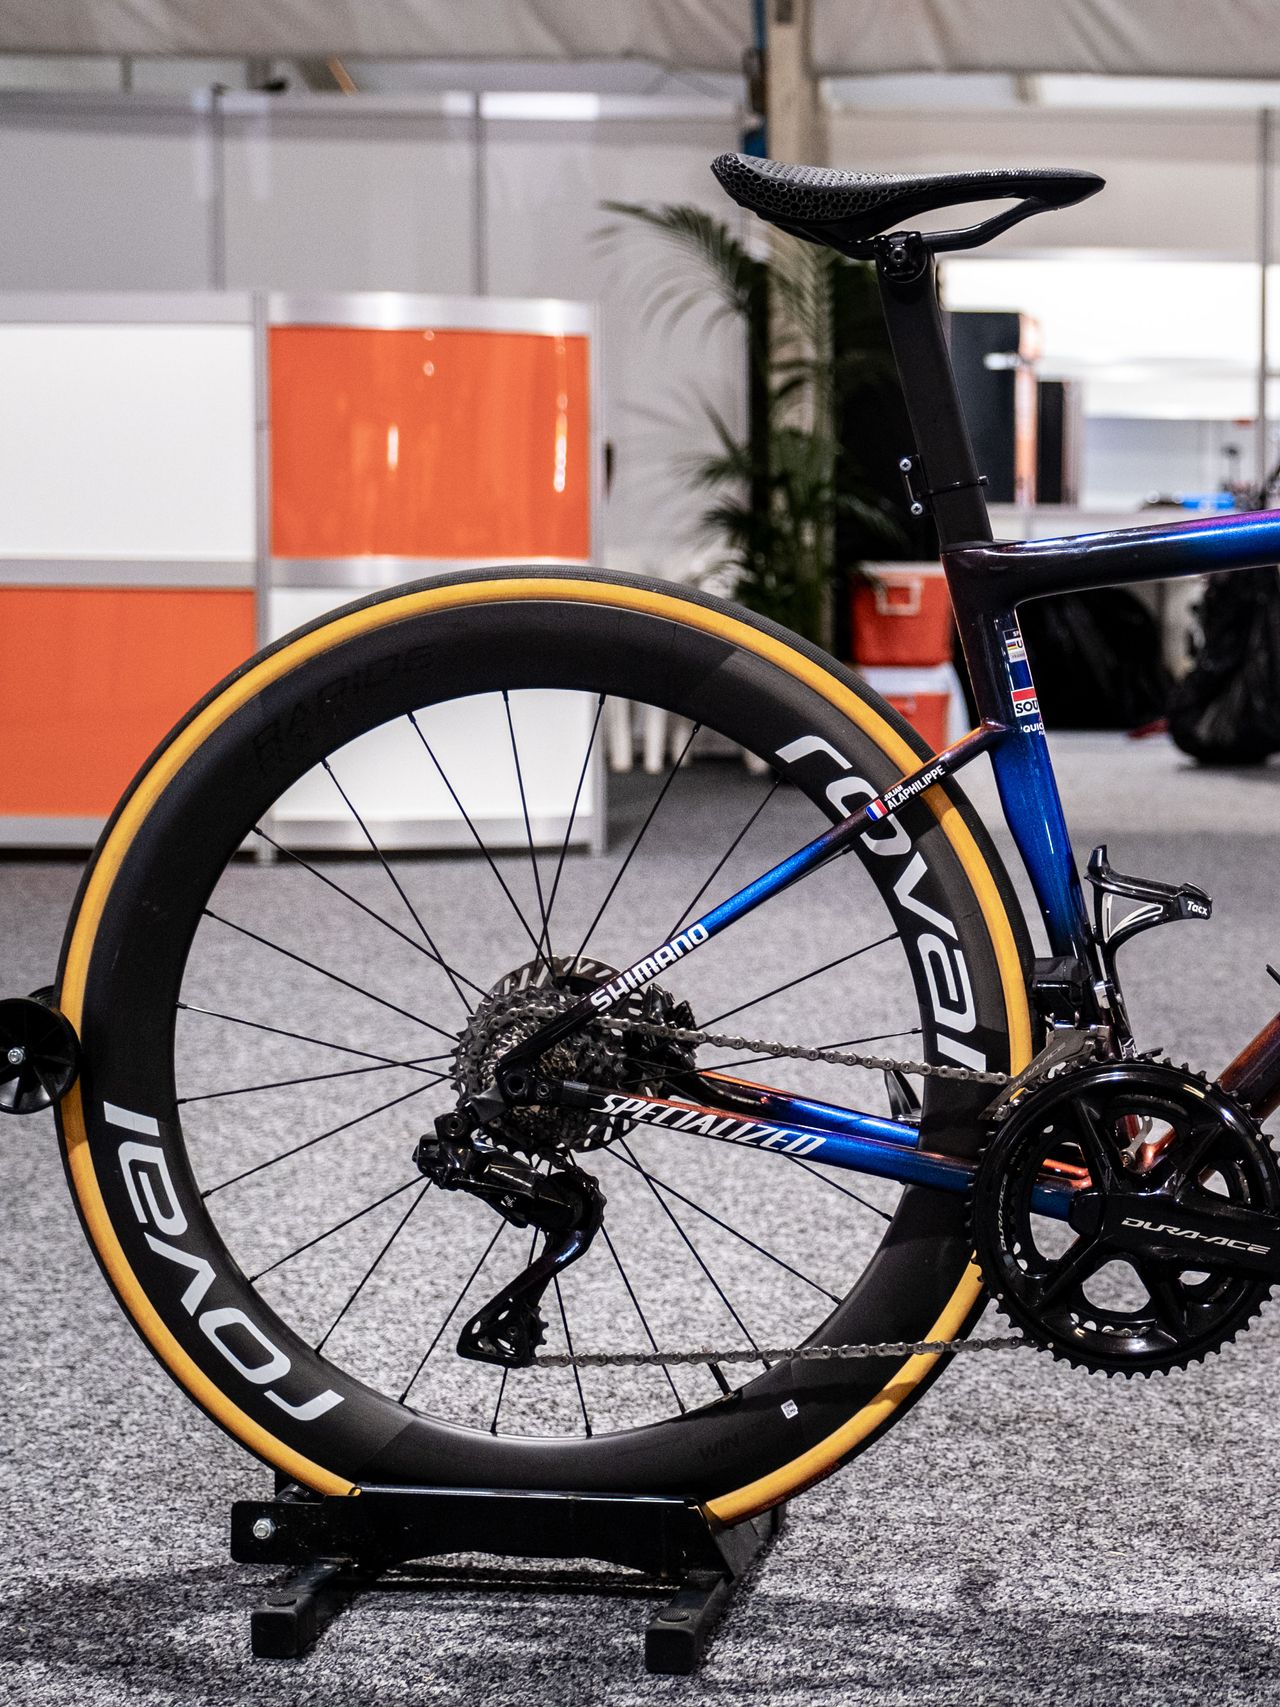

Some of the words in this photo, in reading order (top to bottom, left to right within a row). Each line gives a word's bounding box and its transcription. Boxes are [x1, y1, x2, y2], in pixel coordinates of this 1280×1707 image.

[883, 784, 904, 802] JULIAN
[886, 764, 946, 811] ALAPHILIPPE
[1187, 900, 1208, 916] Tacx
[590, 922, 710, 1013] SHIMANO
[589, 1093, 828, 1156] SPECIALIZED
[1120, 1216, 1272, 1256] DURA-ACE
